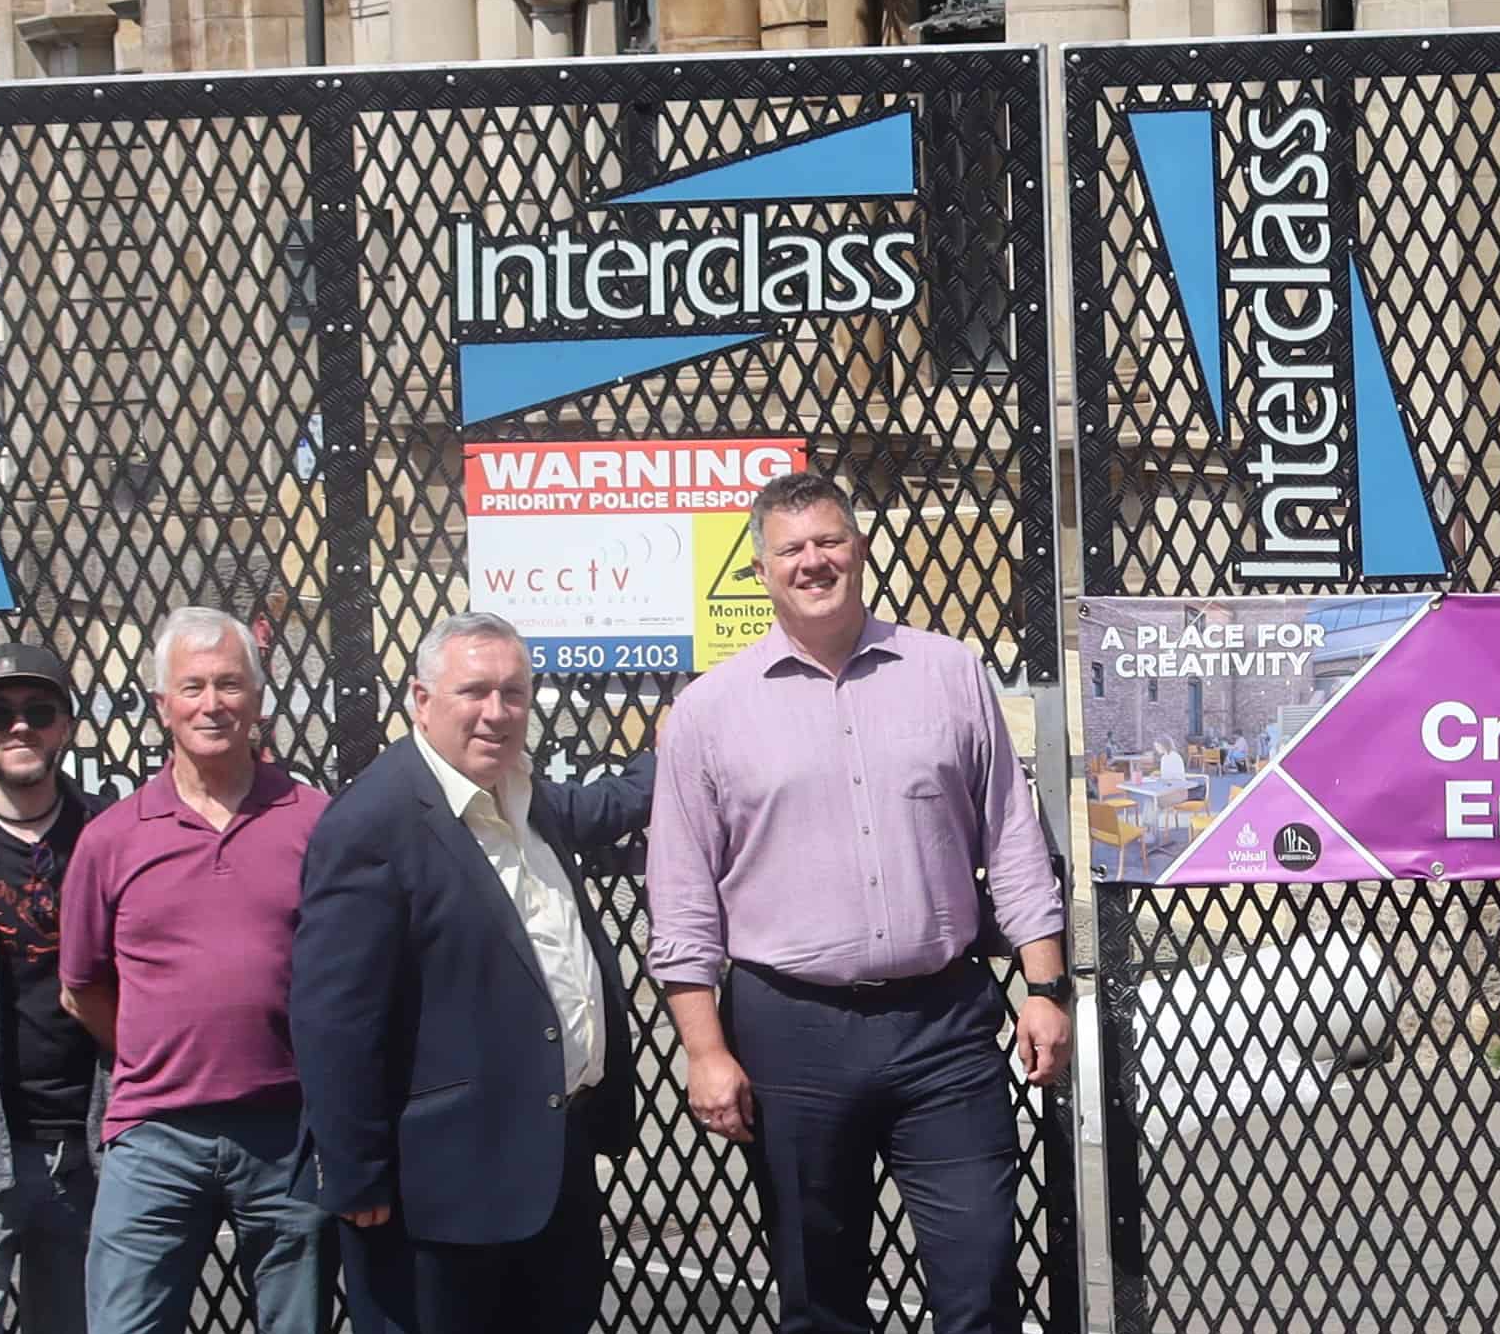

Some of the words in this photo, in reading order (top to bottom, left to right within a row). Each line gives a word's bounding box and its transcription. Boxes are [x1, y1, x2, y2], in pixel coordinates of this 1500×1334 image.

[456, 213, 916, 322] Interclass
[1229, 107, 1341, 577] Interclass
[480, 447, 793, 490] WARNING
[481, 491, 583, 511] PRIORITY
[589, 490, 668, 509] POLICE
[676, 490, 757, 508] RESPON
[709, 604, 776, 618] Monitor
[715, 622, 734, 638] by
[740, 622, 773, 636] CCT
[1101, 627, 1124, 650] A
[1137, 624, 1244, 650] PLACE
[1258, 624, 1325, 648] FOR
[557, 646, 605, 668] 850
[615, 644, 679, 667] 2103
[1115, 652, 1311, 678] CREATIVITY
[1228, 850, 1267, 862] Walsall
[1228, 862, 1267, 874] Council
